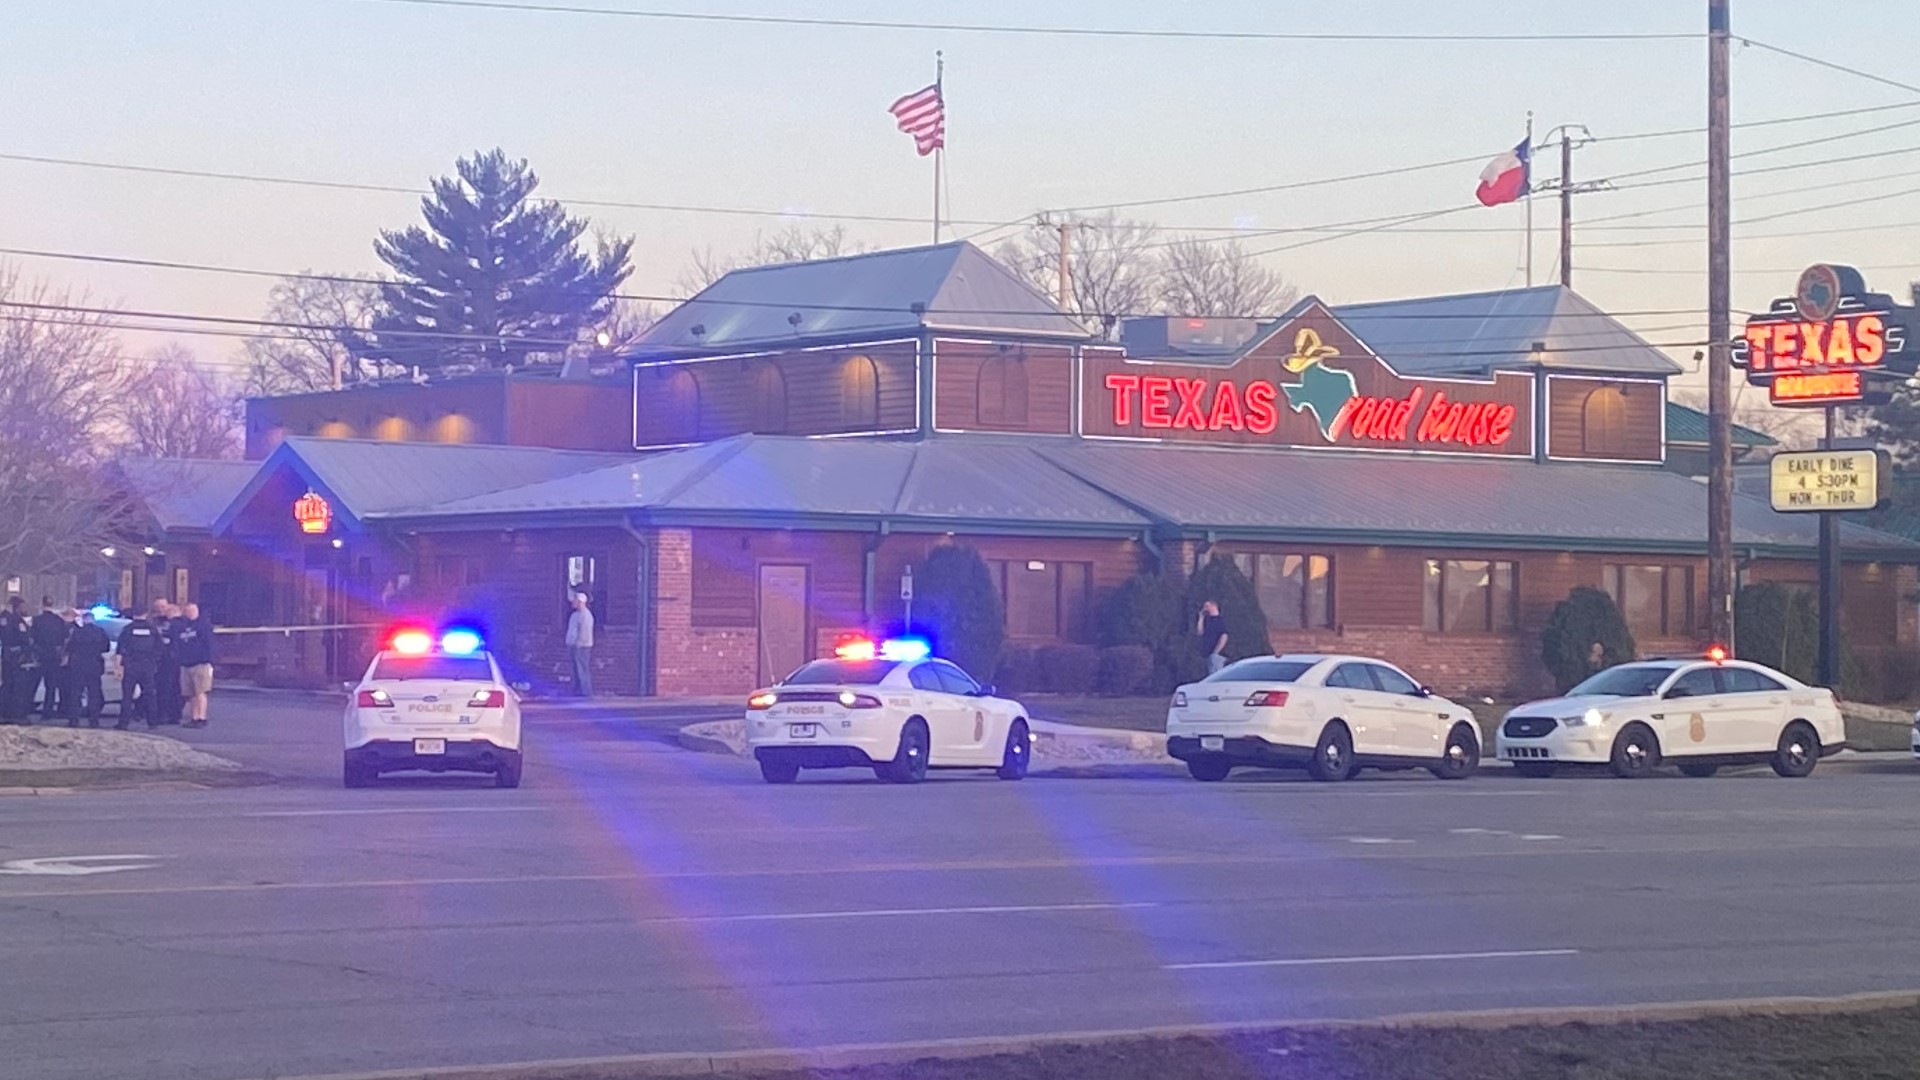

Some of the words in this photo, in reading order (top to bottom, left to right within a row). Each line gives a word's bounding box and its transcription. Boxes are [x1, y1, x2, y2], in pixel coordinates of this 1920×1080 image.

[1746, 317, 1884, 371] TEXAS
[1105, 374, 1278, 434] TEXAS
[1328, 385, 1424, 442] road
[1417, 391, 1516, 447] house
[1788, 459, 1823, 473] EARLY
[1789, 492, 1812, 505] MON
[1827, 490, 1856, 504] THUR
[408, 704, 452, 712] POLICE
